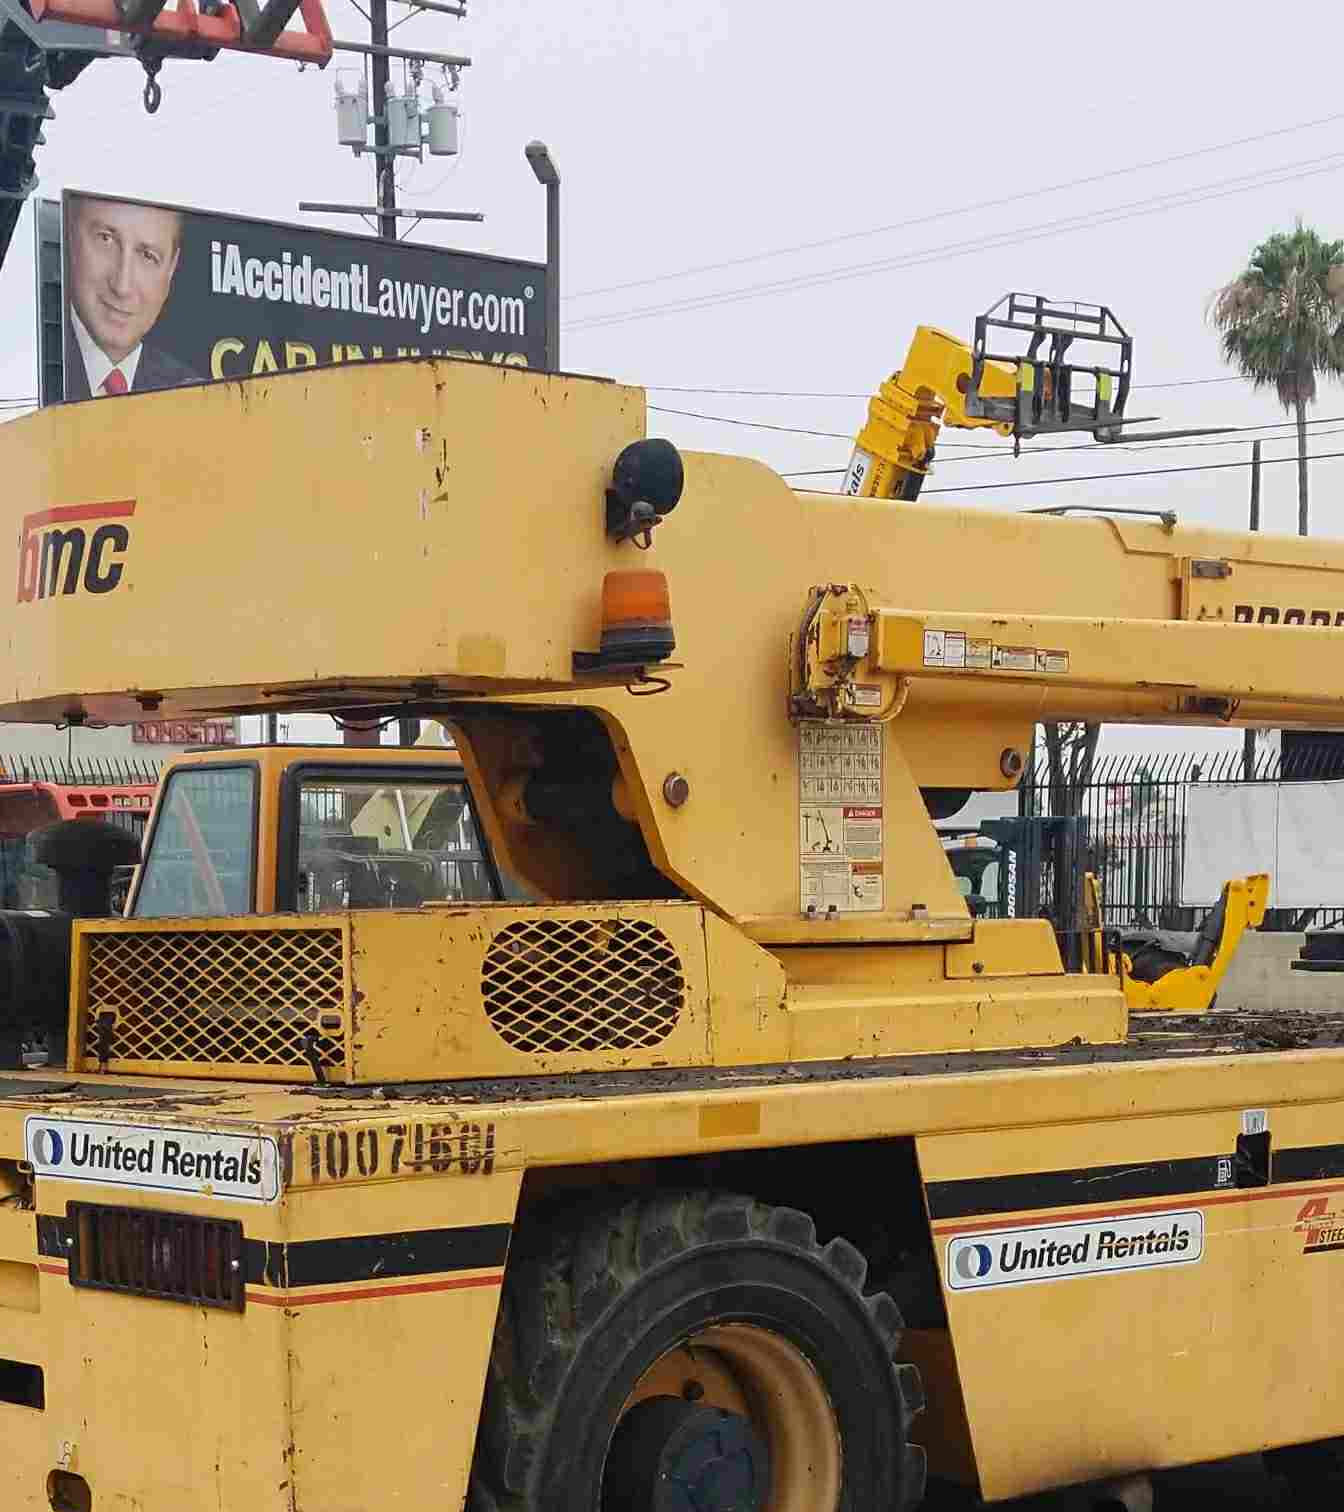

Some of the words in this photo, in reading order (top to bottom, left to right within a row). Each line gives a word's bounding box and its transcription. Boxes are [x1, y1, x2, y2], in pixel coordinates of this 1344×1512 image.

[1008, 849, 1017, 918] DOOSAN
[70, 1132, 155, 1174] United
[161, 1139, 262, 1185] Rentals
[999, 1233, 1090, 1273] United
[1096, 1223, 1190, 1261] Rentals
